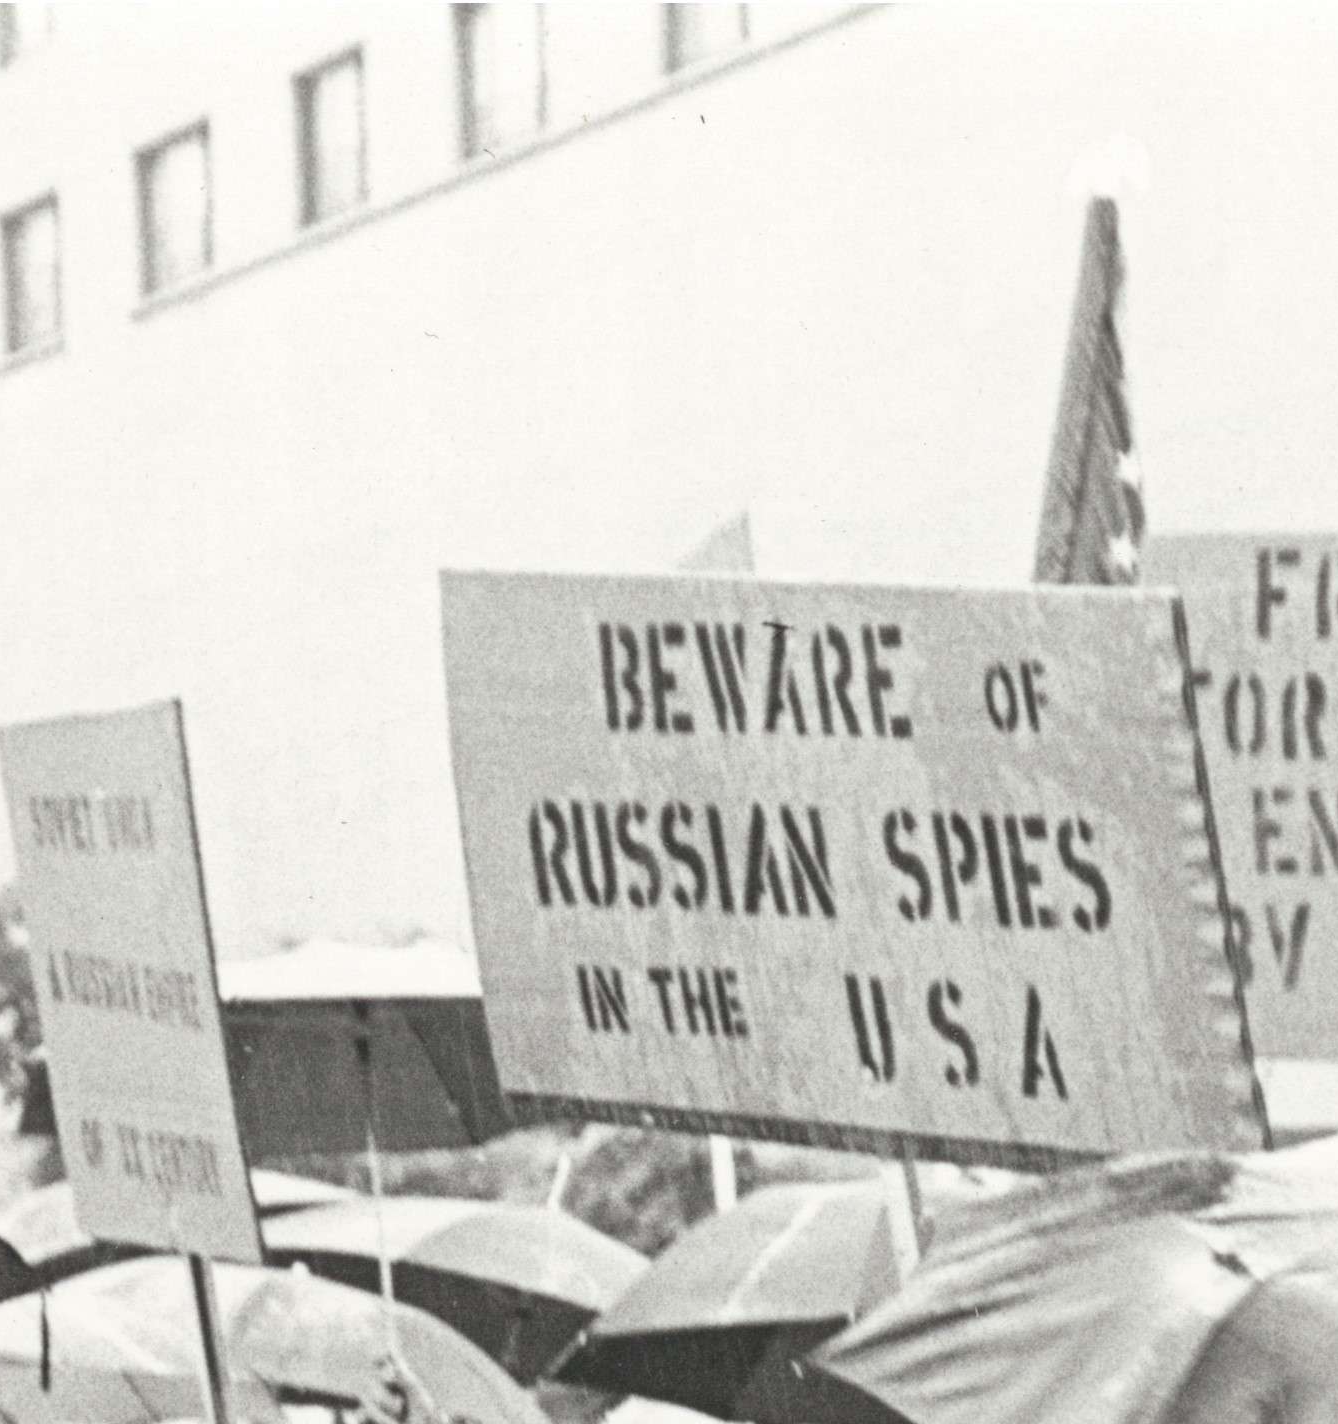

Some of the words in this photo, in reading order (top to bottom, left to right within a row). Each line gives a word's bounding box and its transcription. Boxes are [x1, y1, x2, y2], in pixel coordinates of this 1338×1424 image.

[597, 622, 913, 739] BEWARE
[983, 659, 1048, 732] OF
[528, 800, 837, 918] RUSSIAN
[881, 807, 1112, 933] SPIES
[575, 965, 631, 1036] IN
[647, 965, 749, 1039] THE
